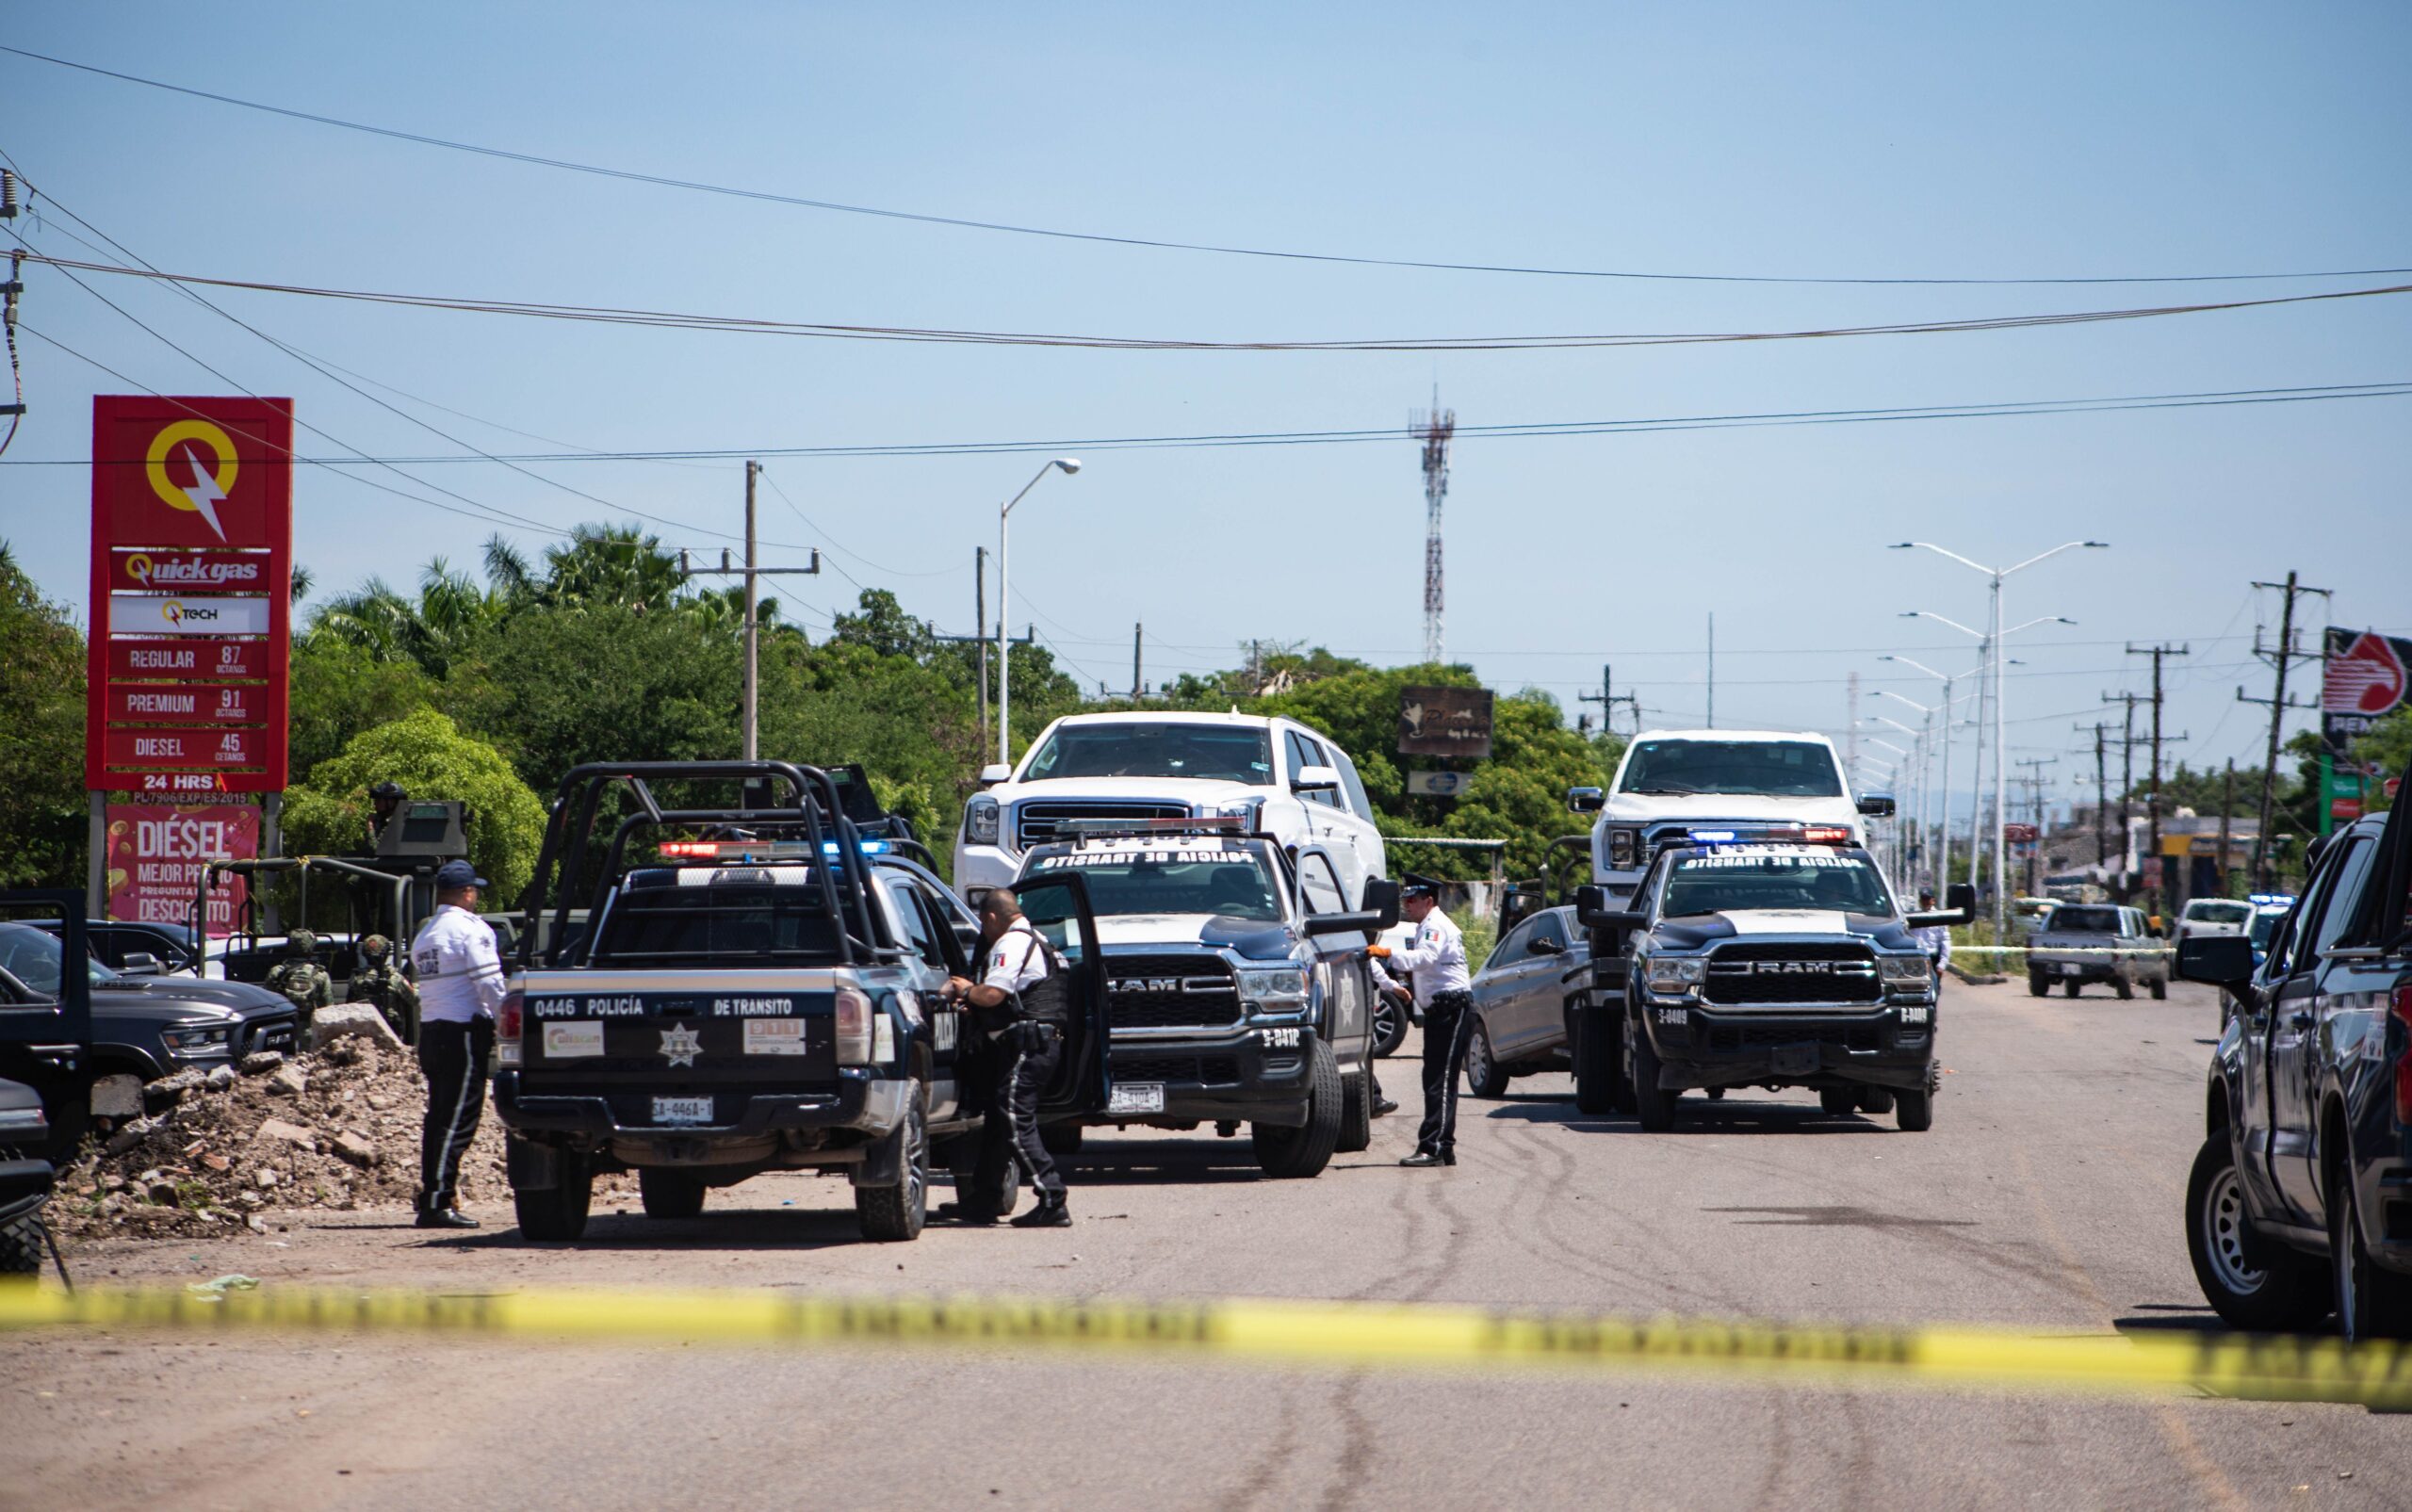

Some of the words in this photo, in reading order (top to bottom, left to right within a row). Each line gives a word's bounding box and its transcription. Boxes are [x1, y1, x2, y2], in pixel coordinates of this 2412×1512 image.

[130, 650, 195, 668] REGULAR
[221, 645, 241, 664] 87
[216, 664, 247, 674] OCTANOS
[127, 693, 195, 712] PREMIUM
[221, 689, 240, 707] 91
[216, 708, 247, 718] OCTANOS
[135, 739, 185, 756] DIESEL
[220, 733, 240, 752] 45
[144, 774, 168, 789] 24
[173, 774, 214, 789] HRS
[138, 863, 182, 883] MEJOR
[139, 886, 194, 896] PREGUNTA
[218, 888, 231, 897] TU
[1757, 962, 1831, 973] RAM
[534, 999, 576, 1017] 0446
[586, 995, 644, 1016] POLICÍA
[713, 999, 730, 1016] DE
[732, 999, 792, 1016] TRANSITO
